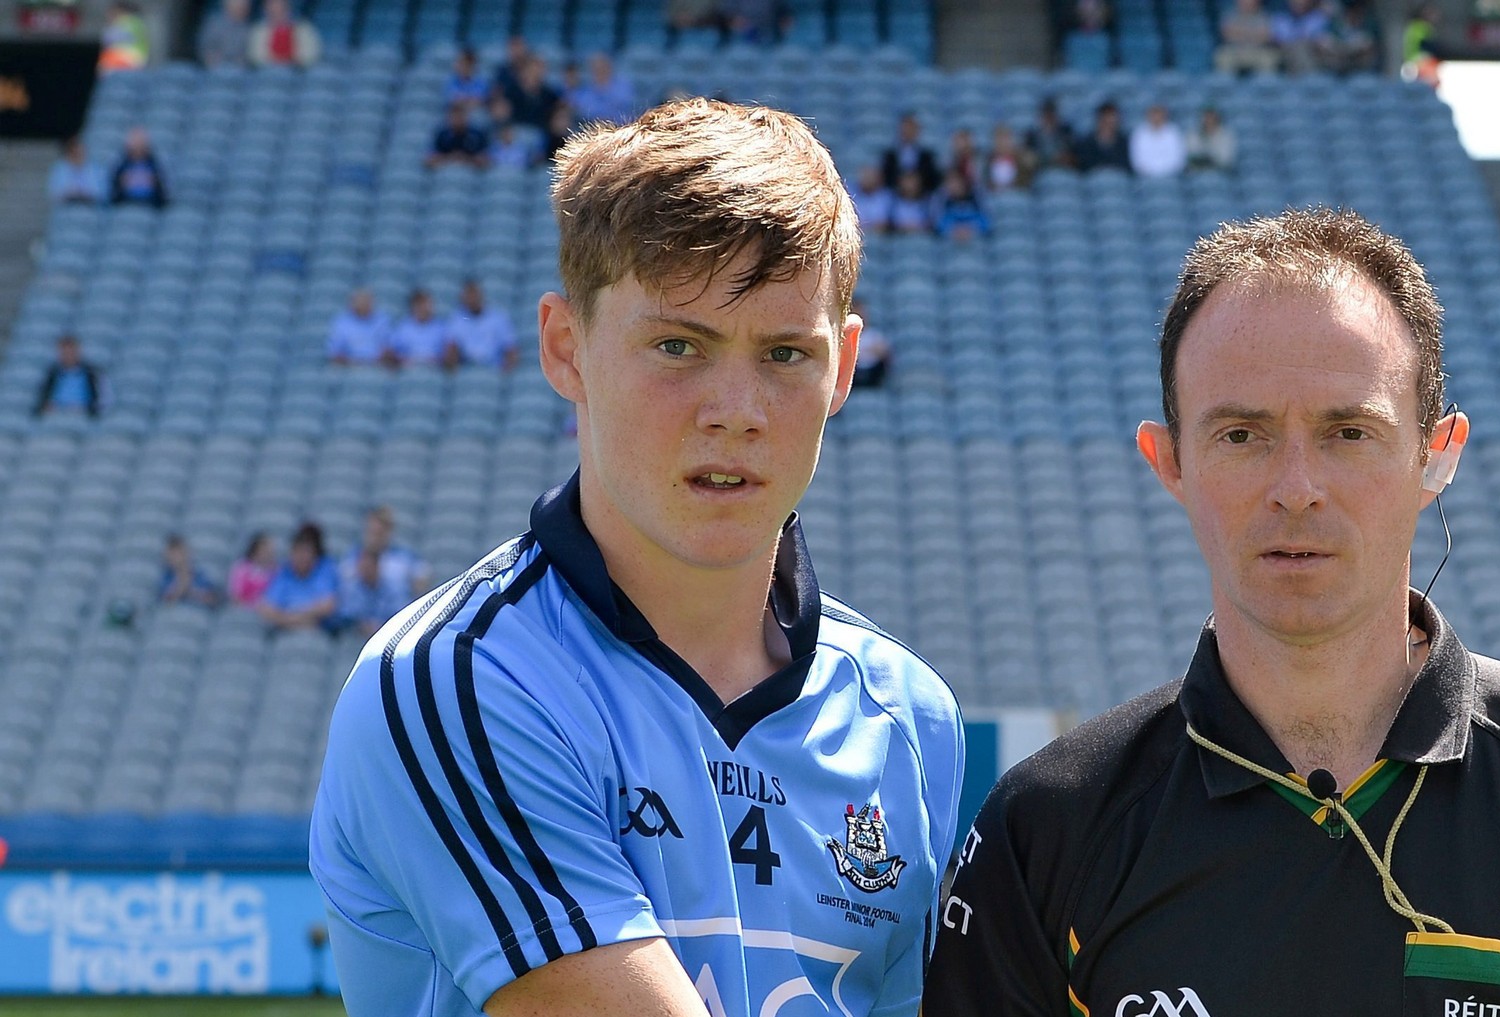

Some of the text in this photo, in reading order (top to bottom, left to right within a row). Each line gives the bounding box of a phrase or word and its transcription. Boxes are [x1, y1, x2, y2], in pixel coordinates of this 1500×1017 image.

[706, 761, 786, 805] NEILLS
[729, 805, 781, 885] 4
[7, 873, 266, 934] electric
[816, 893, 850, 910] LEINSTER
[871, 907, 901, 924] FOOTBALL
[845, 911, 862, 925] FINAL
[49, 931, 271, 993] Ireland
